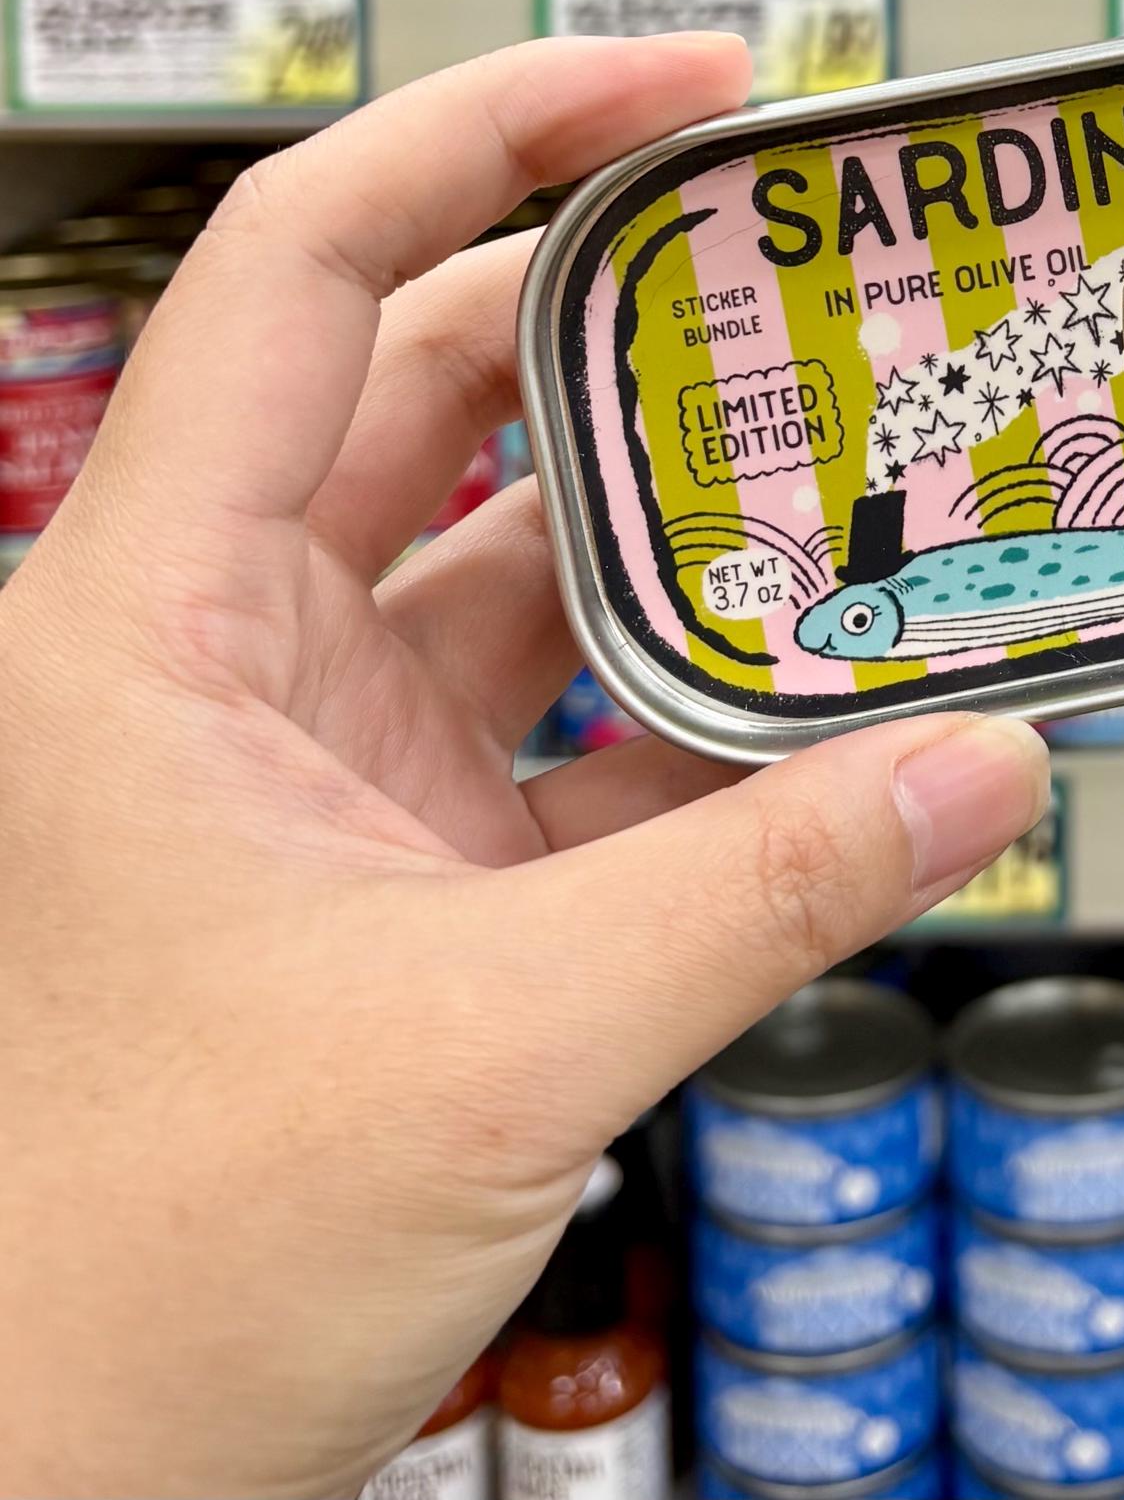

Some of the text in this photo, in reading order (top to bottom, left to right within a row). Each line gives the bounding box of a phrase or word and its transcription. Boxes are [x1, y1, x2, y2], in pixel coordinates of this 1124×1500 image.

[825, 245, 1091, 317] IN PURE OLIVE OIL
[672, 286, 757, 319] STICKER
[684, 315, 762, 347] BUNDLE
[697, 384, 818, 432] LIMITED
[702, 415, 825, 465] EDITION
[708, 557, 778, 585] NET WT
[713, 582, 783, 610] 3.7 OZ
